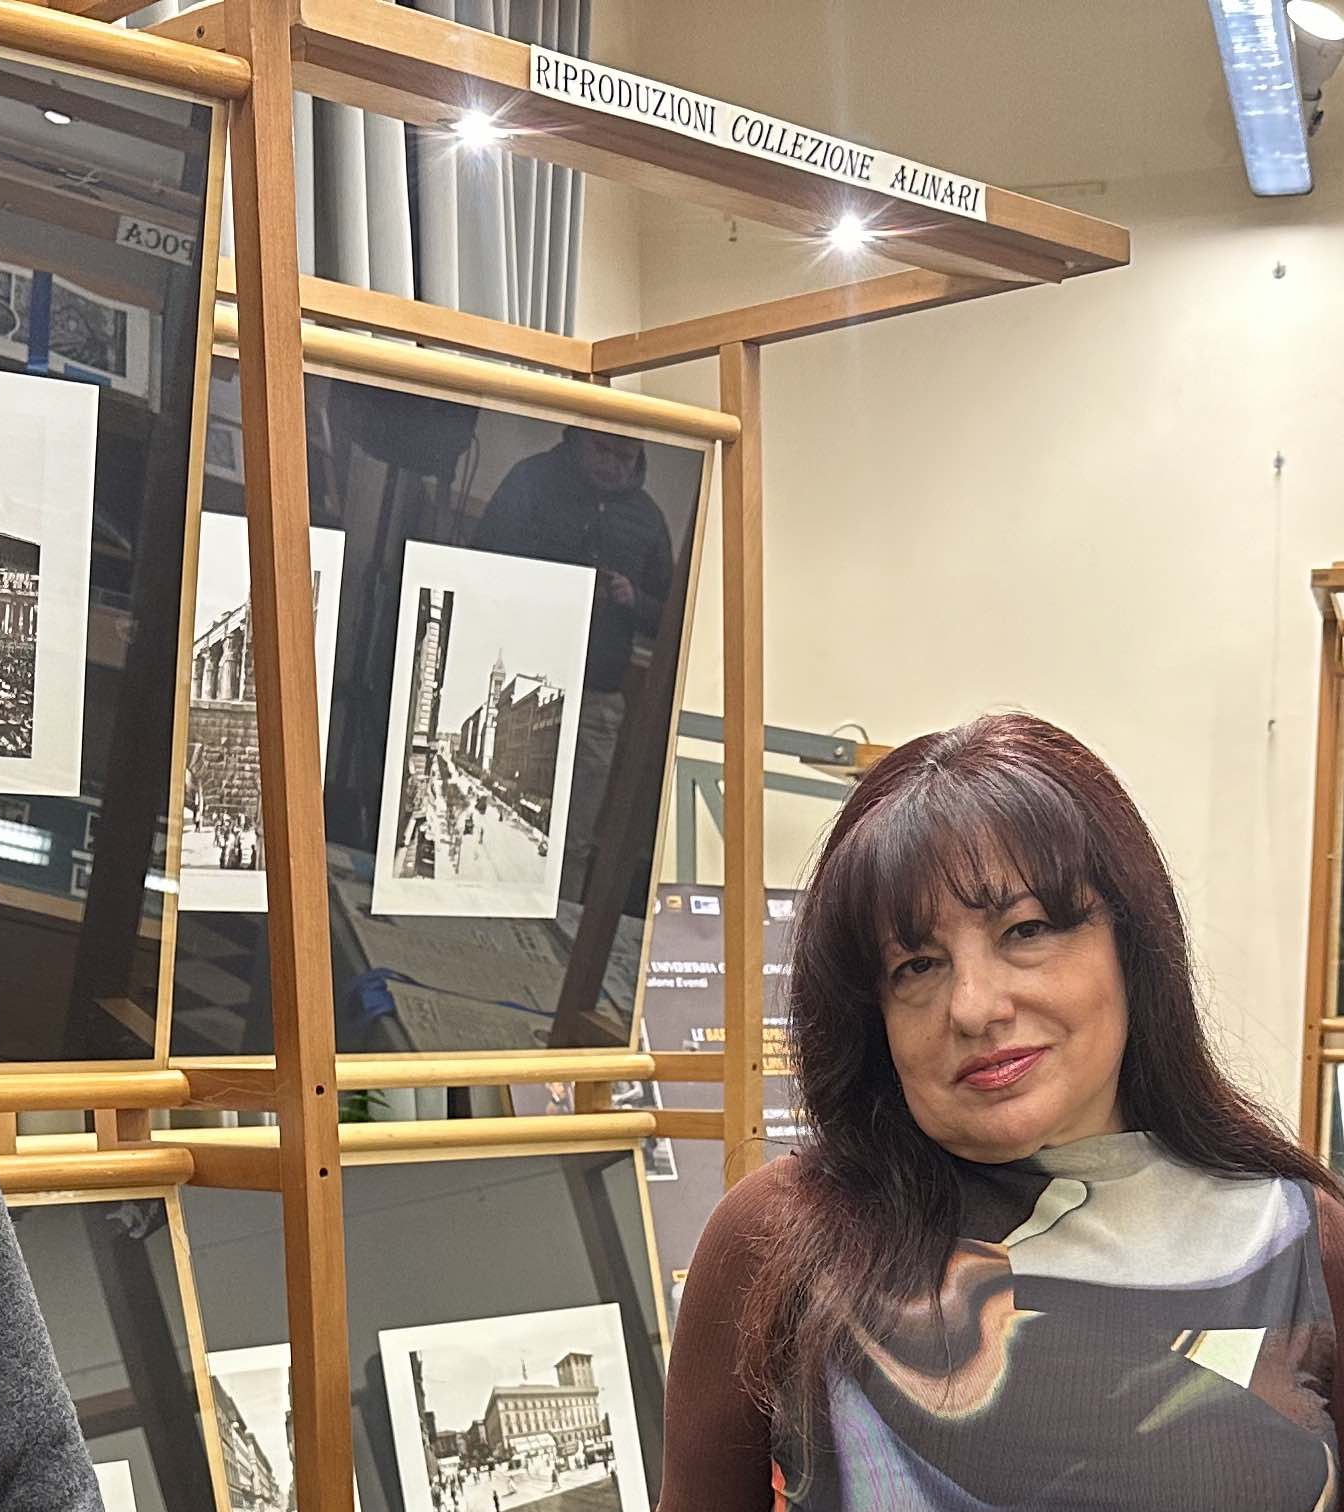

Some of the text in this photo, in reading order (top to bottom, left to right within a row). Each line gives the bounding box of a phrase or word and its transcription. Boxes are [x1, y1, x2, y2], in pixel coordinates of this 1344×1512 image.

[536, 55, 980, 212] RIPRODUZIONI COLLEZIONE ALINARI
